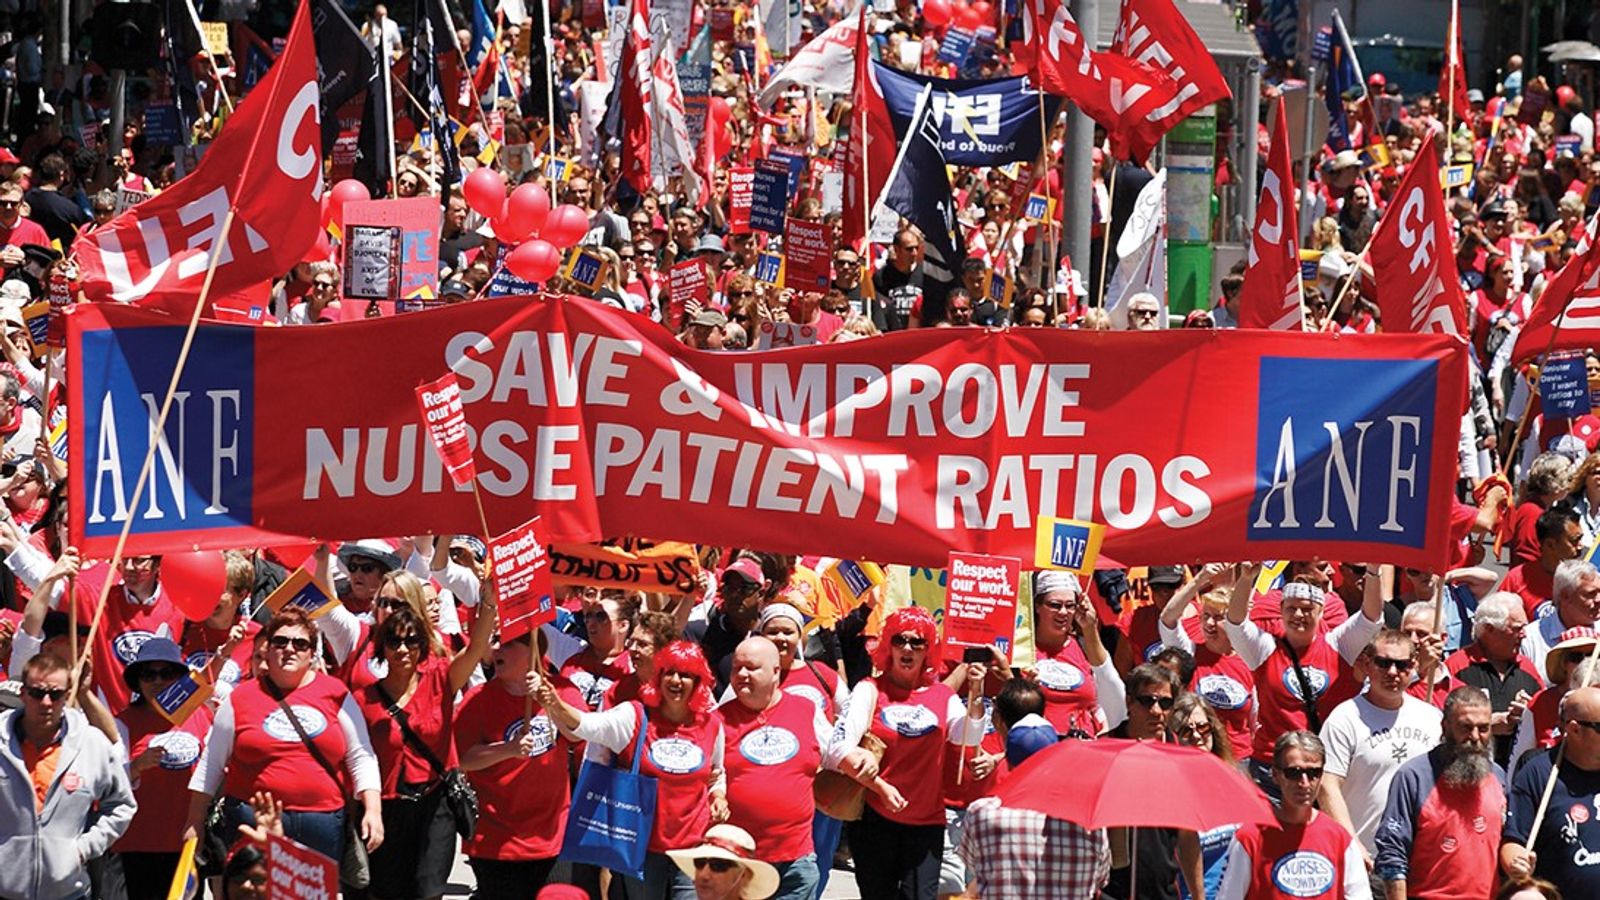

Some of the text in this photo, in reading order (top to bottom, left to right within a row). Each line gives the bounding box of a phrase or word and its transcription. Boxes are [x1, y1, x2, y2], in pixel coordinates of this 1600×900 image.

[788, 223, 823, 239] Respect
[788, 236, 802, 245] our
[572, 261, 599, 284] ANF
[492, 284, 509, 293] our
[445, 330, 1091, 438] SAVE & IMPROVE
[427, 404, 449, 422] our
[88, 389, 241, 524] ANF
[303, 421, 1213, 530] NURSE PATIENT RATIOS
[1252, 415, 1421, 532] ANF
[492, 529, 537, 562] Respect
[1052, 535, 1086, 568] ANF
[496, 543, 546, 576] our work.
[952, 559, 1008, 581] Respect
[654, 558, 696, 593] US
[951, 578, 1015, 597] our work.
[157, 681, 189, 711] NF
[1364, 726, 1431, 749] ZOO YORK
[271, 842, 324, 884] Respect
[1281, 859, 1329, 875] NURSES
[271, 866, 293, 889] our
